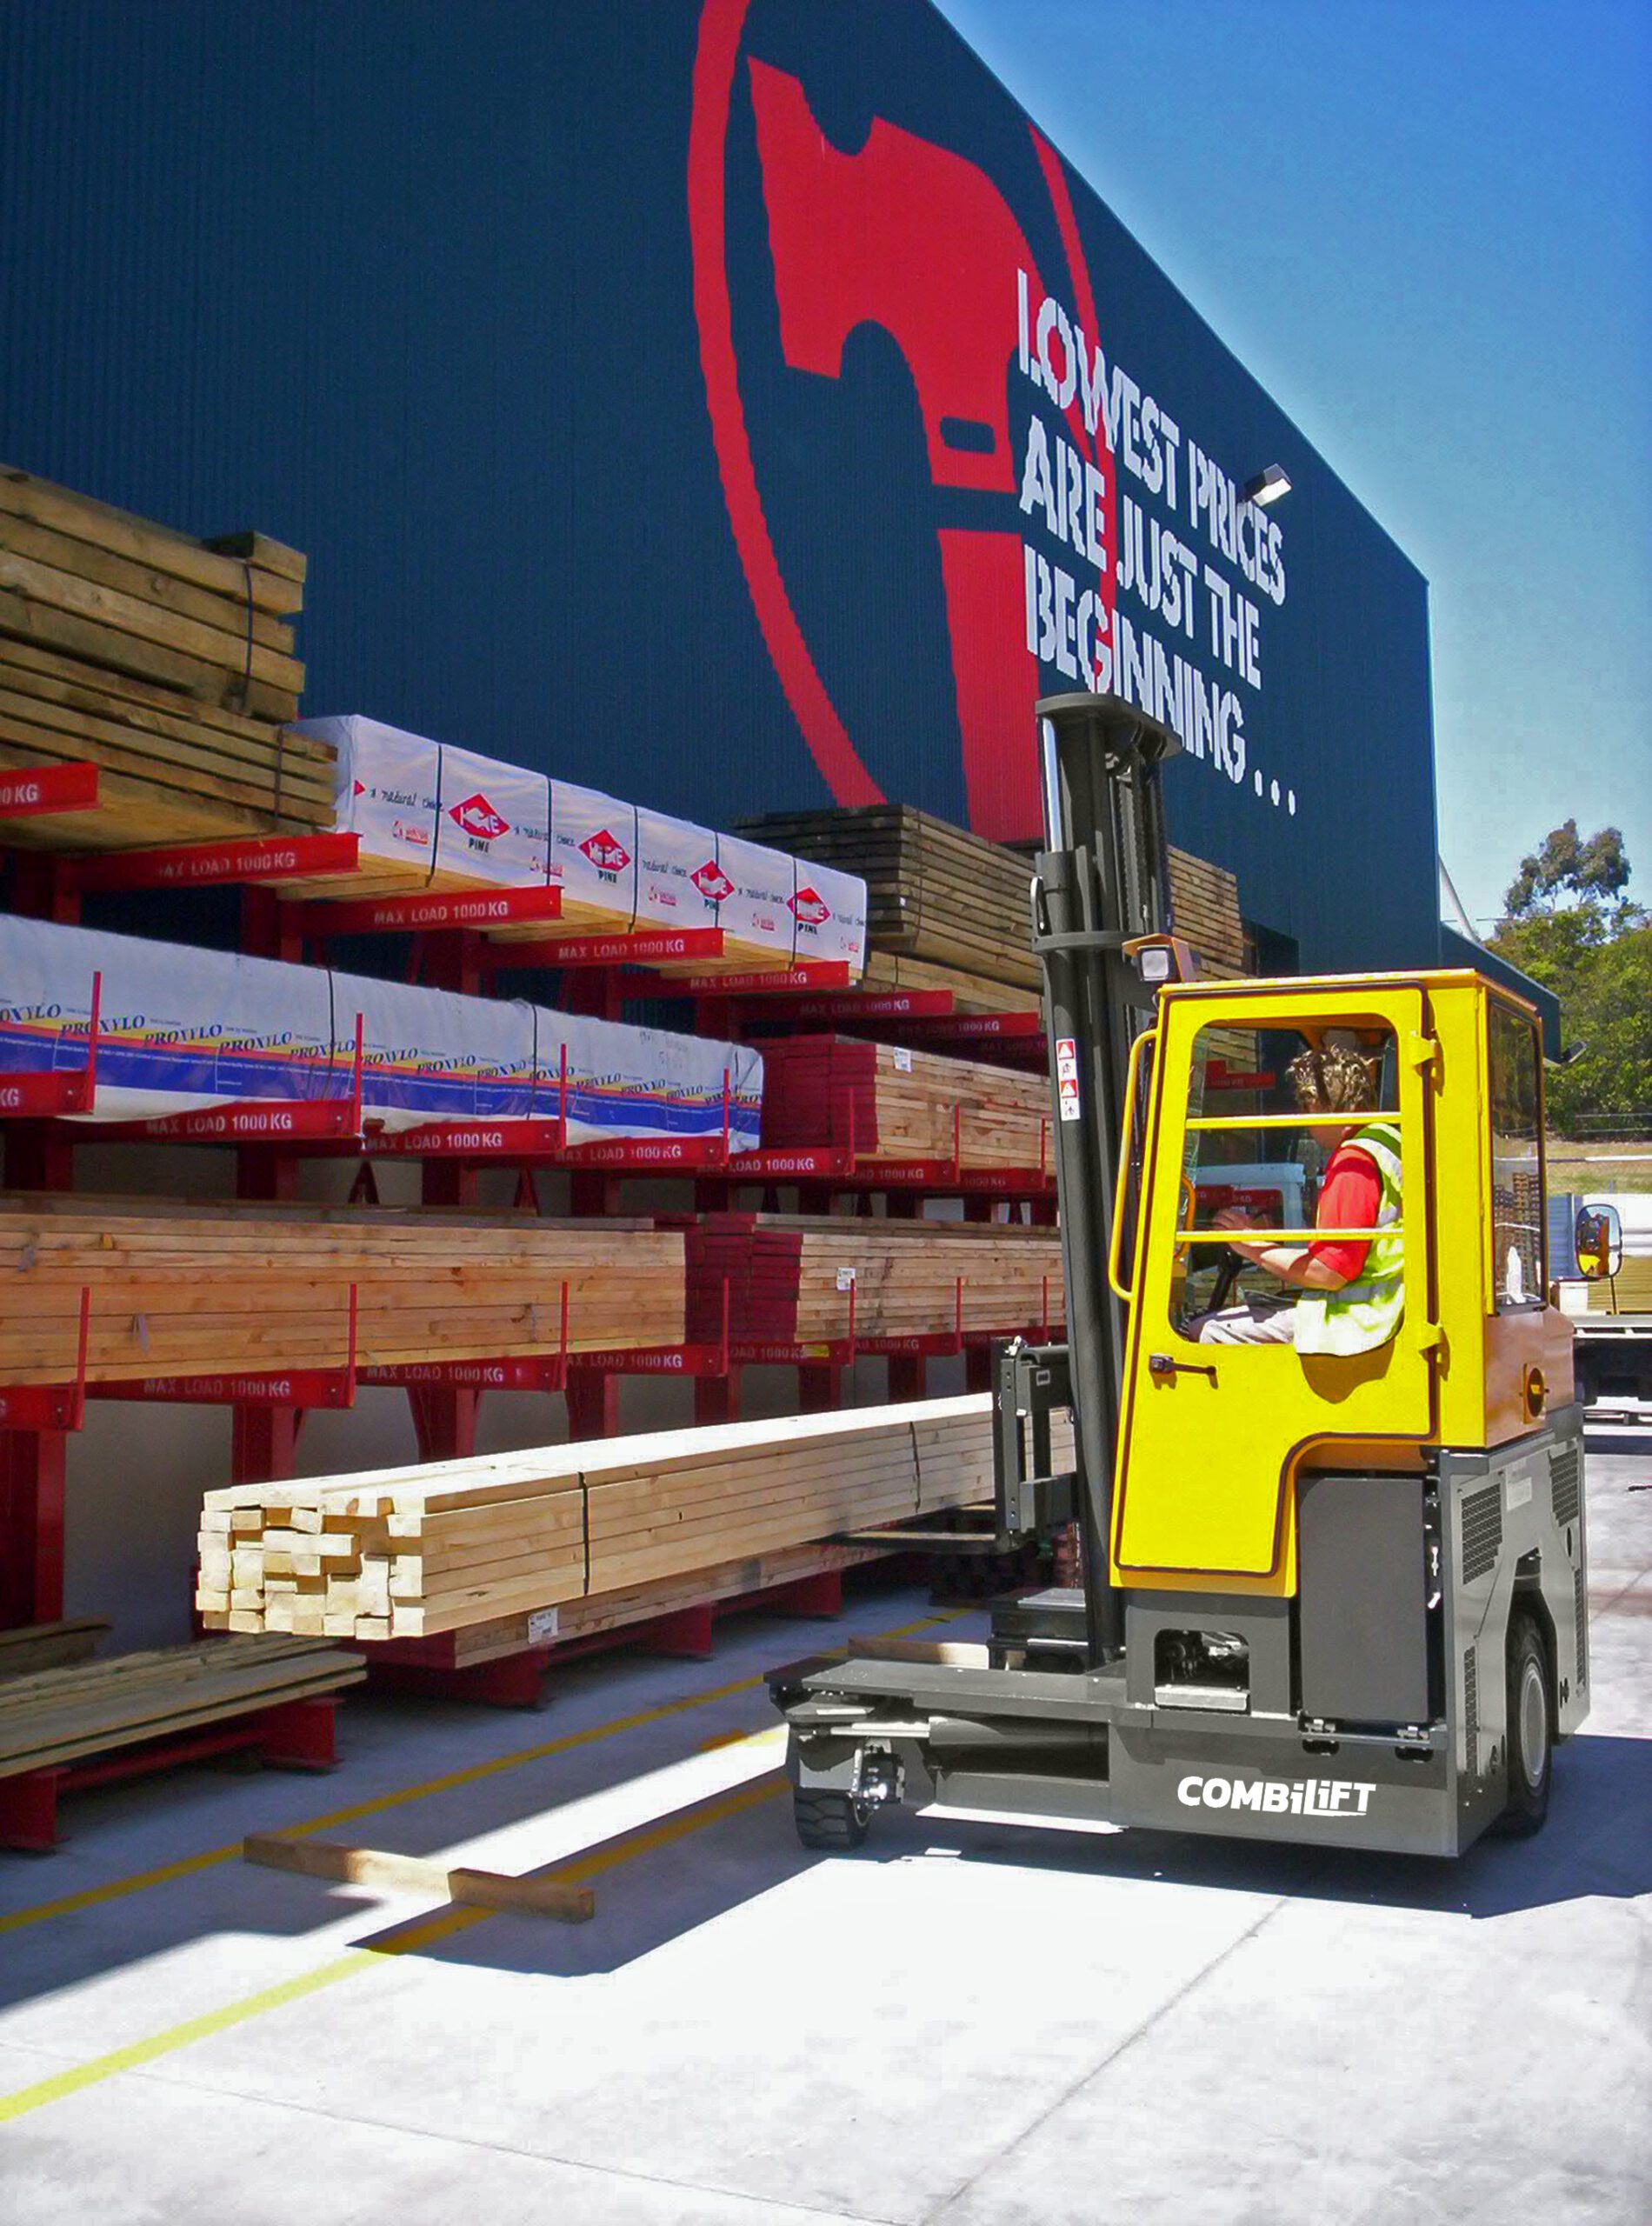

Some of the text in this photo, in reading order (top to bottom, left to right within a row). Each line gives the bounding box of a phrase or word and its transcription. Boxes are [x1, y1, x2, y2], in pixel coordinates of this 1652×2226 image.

[1018, 268, 1286, 606] LOWEST PRICES
[1019, 415, 1261, 690] ARE JUST THE
[15, 783, 39, 803] KG
[236, 853, 271, 870] 1000
[273, 851, 296, 869] KG
[374, 901, 509, 924] MAX LOAD 1000 KG
[558, 938, 684, 960] MAX LOAD 1000 KG
[759, 973, 789, 985] 1000
[789, 971, 807, 984] KG
[0, 1003, 61, 1023] OXYLO
[893, 999, 910, 1010] KG
[143, 1023, 223, 1047] PROXYLO
[984, 1020, 1000, 1031] KG
[219, 1031, 293, 1054] PROXYLO
[145, 1113, 292, 1135] MAX LOAD 1000 KG
[404, 1134, 442, 1150] LOAD
[445, 1132, 479, 1149] 1000
[482, 1131, 503, 1148] KG
[590, 1147, 624, 1161] LOAD
[663, 1144, 682, 1158] KG
[766, 1158, 795, 1171] 1000
[796, 1157, 815, 1171] KG
[878, 1169, 906, 1181] 1000
[907, 1169, 925, 1181] KG
[989, 1176, 1006, 1187] KG
[760, 1347, 789, 1359] 1000
[903, 1339, 920, 1350] KG
[566, 1355, 583, 1368] AX
[631, 1354, 662, 1368] 1000
[663, 1354, 683, 1369] KG
[367, 1365, 398, 1381] MAX
[403, 1365, 441, 1381] LOAD
[448, 1367, 481, 1383] 1000
[483, 1368, 504, 1383] KG
[184, 1378, 223, 1396] LOAD
[230, 1380, 266, 1396] 1000
[268, 1380, 290, 1397] KG
